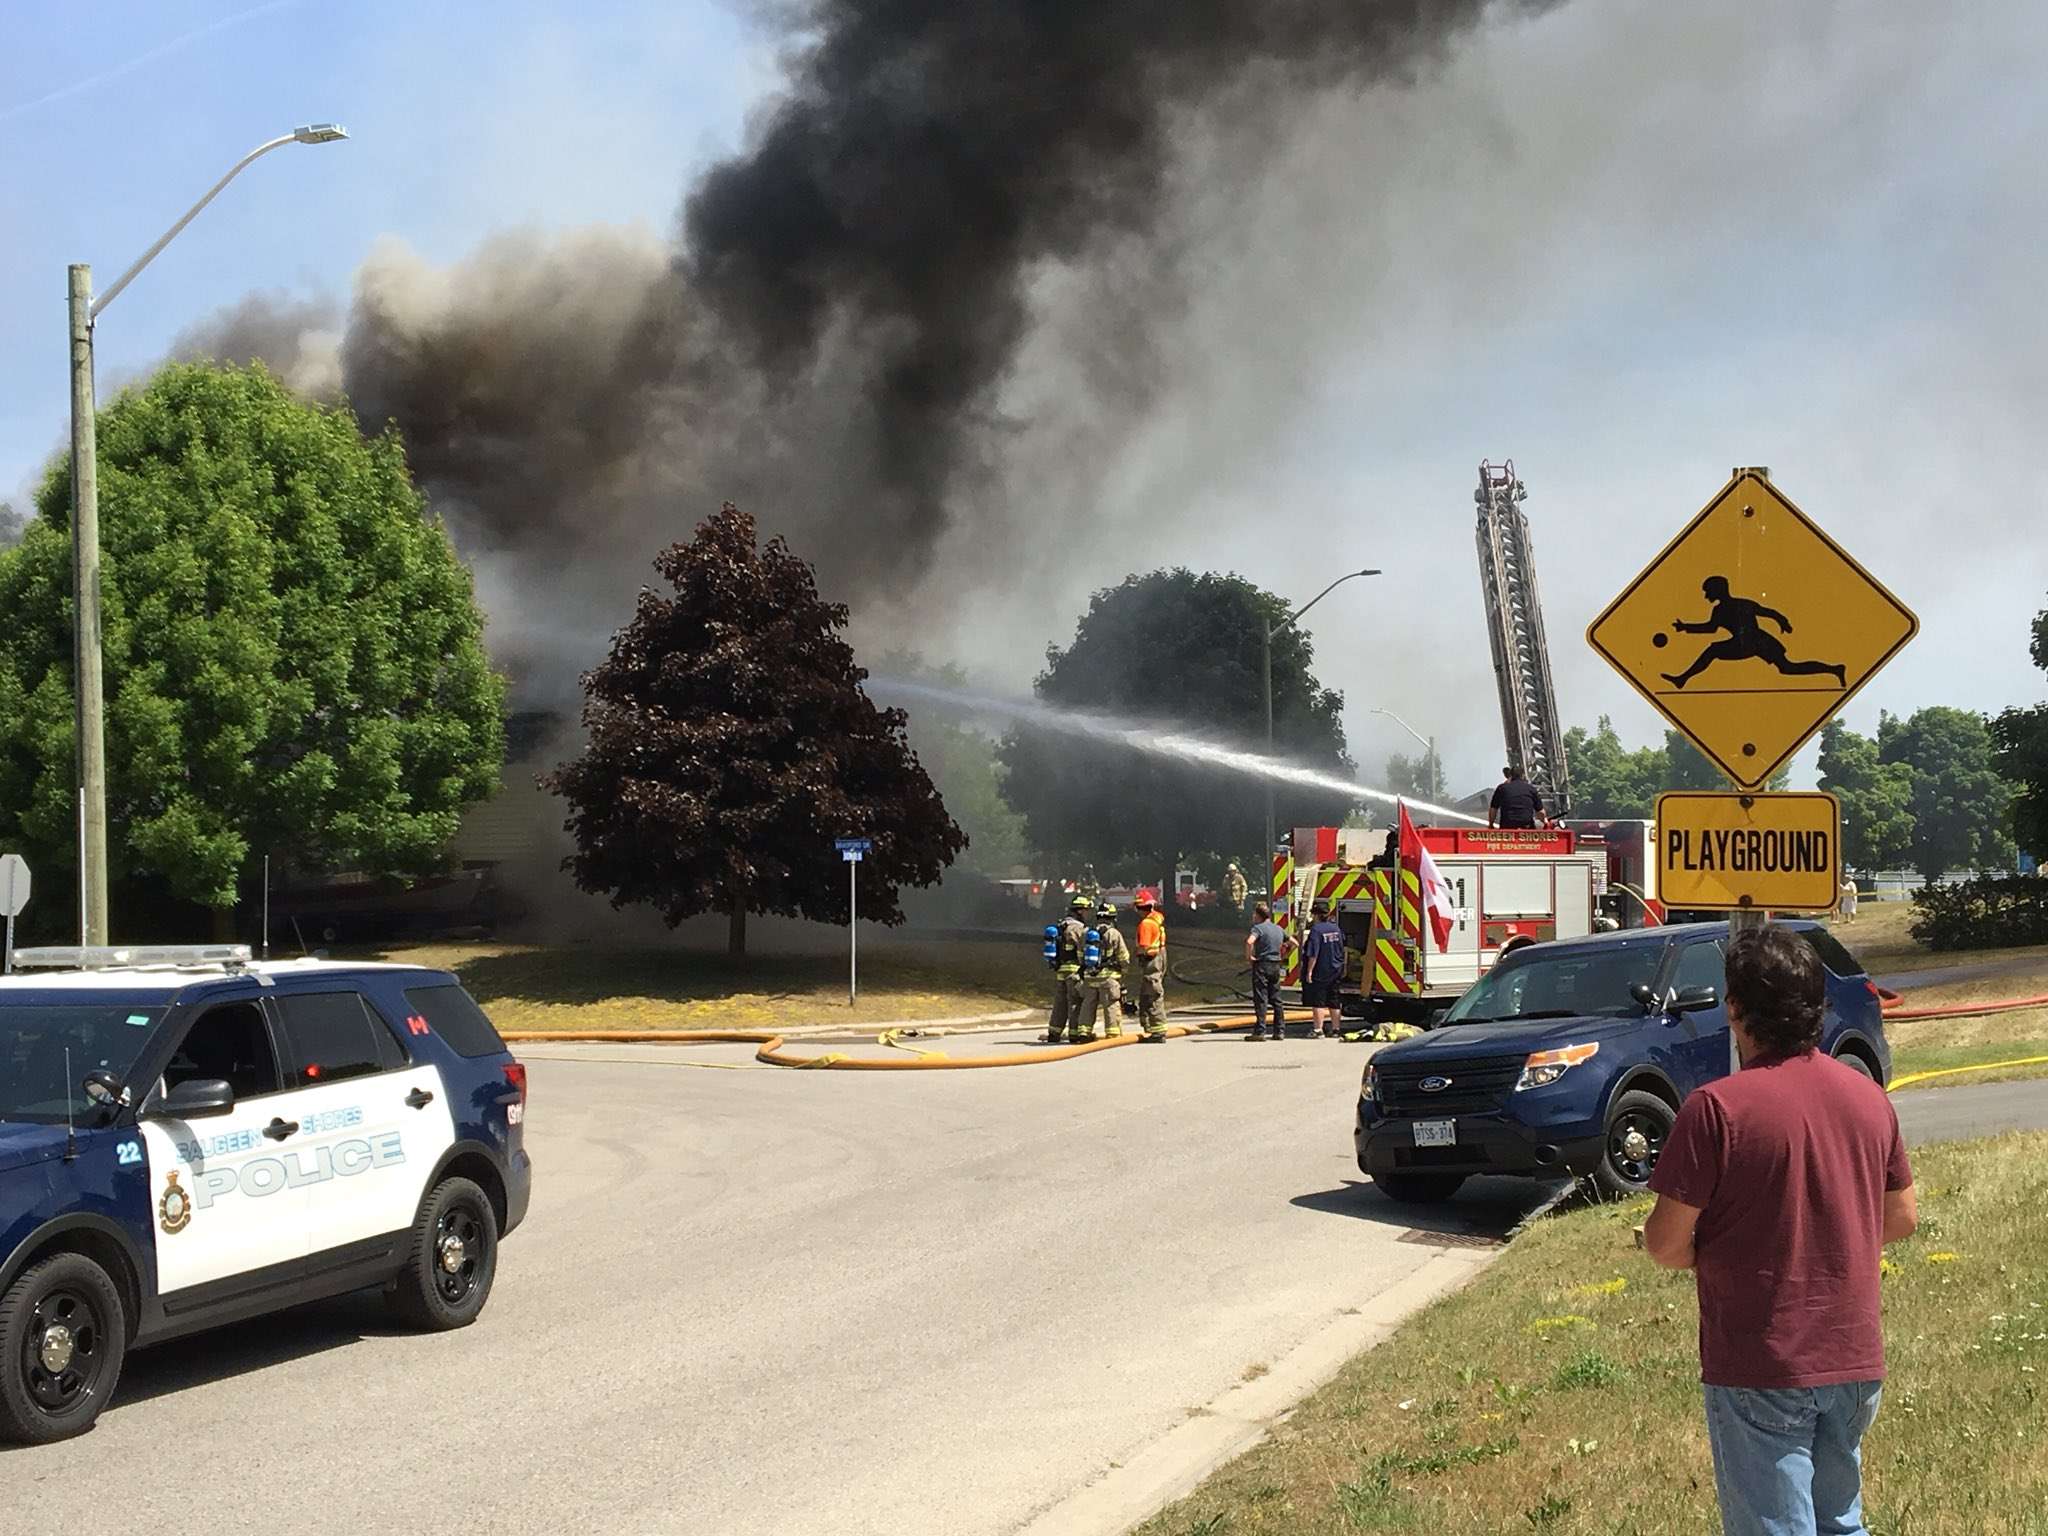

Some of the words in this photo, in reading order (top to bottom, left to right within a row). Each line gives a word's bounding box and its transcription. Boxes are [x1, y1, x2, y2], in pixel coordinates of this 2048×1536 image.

[1467, 831, 1516, 842] SAUGEEN
[1519, 831, 1560, 842] SHORES
[1487, 843, 1501, 851] FIRE
[1668, 829, 1828, 873] PLAYGROUND
[176, 1128, 263, 1164] SAUGEEN
[301, 1105, 364, 1136] SHORES
[116, 1140, 143, 1165] 22
[192, 1130, 407, 1210] POLICE
